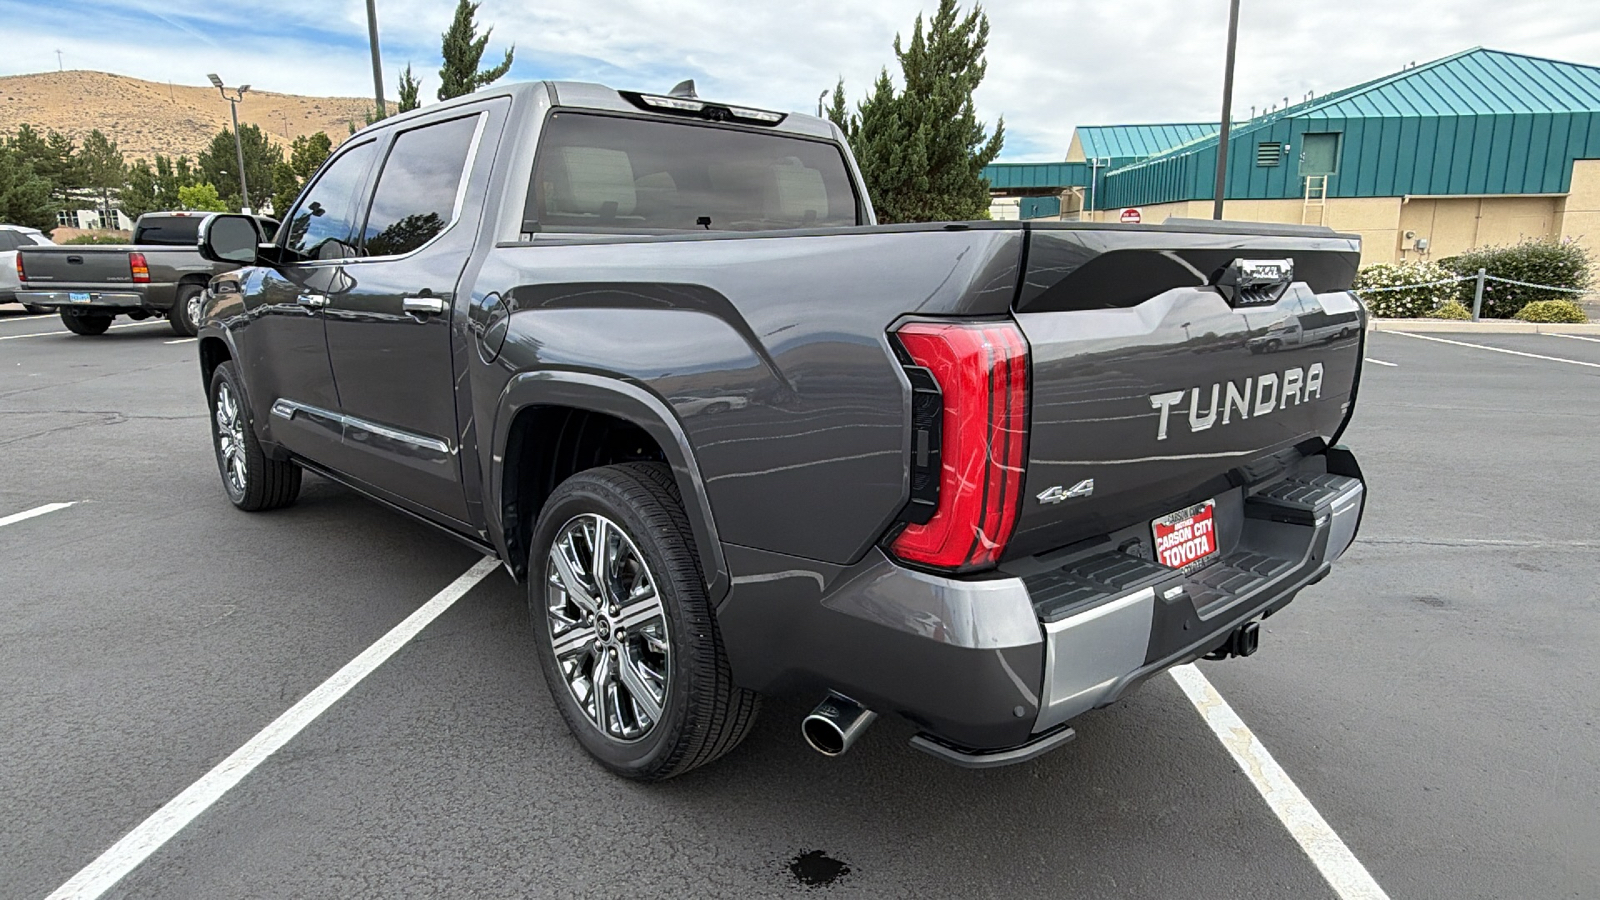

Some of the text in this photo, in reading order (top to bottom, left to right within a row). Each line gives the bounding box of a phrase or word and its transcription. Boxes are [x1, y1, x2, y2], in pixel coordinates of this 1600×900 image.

[1149, 362, 1324, 440] TUNDRA
[1157, 518, 1212, 550] CARSON CITY
[1163, 535, 1208, 567] TOYOTA
